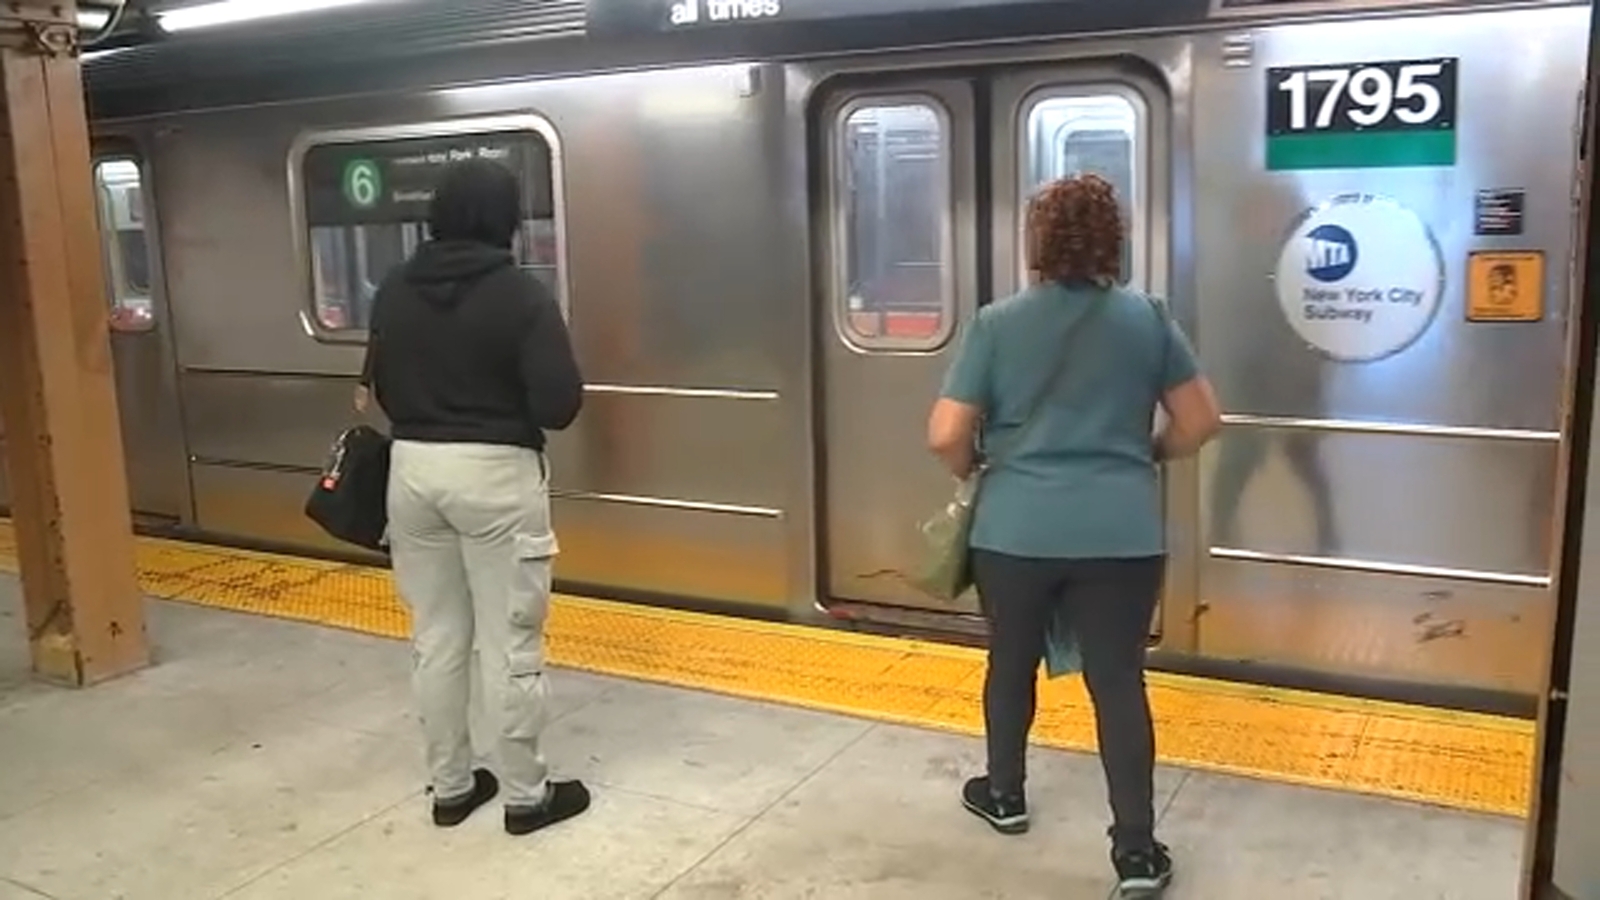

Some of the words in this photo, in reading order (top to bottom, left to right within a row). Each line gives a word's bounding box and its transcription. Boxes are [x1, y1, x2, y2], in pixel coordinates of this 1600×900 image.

[671, 0, 698, 23] all
[708, 0, 780, 20] times
[1279, 65, 1441, 129] 1795
[351, 164, 374, 204] 6
[1303, 288, 1340, 302] New
[1344, 288, 1383, 302] York
[1387, 287, 1424, 306] City
[1303, 304, 1373, 323] Subway
